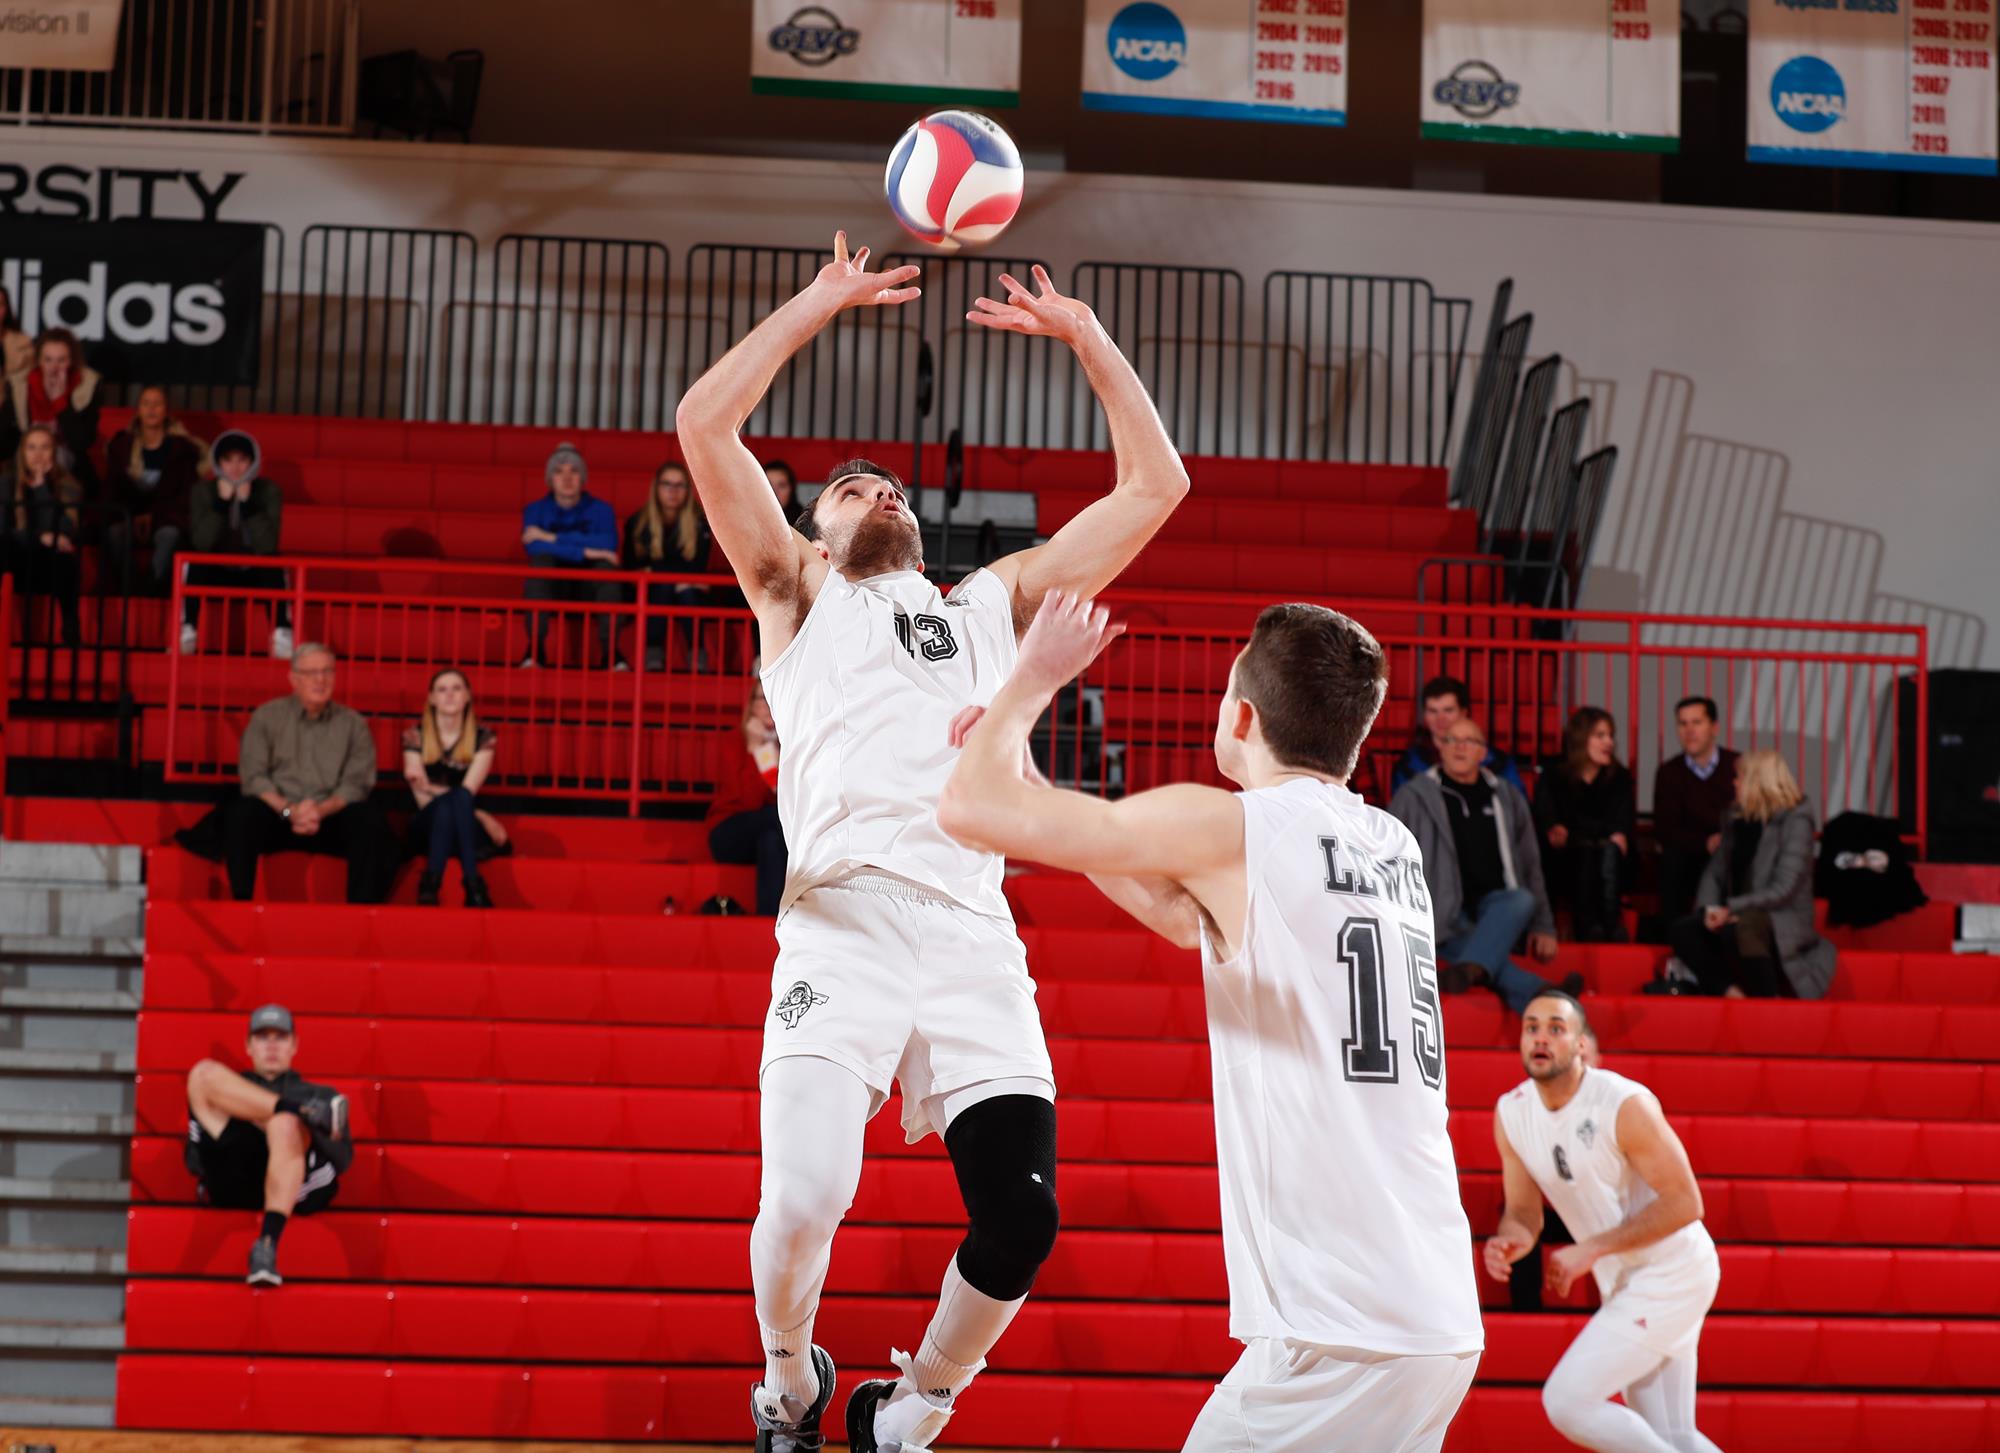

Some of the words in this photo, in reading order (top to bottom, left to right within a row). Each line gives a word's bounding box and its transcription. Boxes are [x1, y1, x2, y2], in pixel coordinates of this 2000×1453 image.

[769, 26, 860, 55] GLVC
[1113, 37, 1187, 64] NCAA
[1433, 78, 1521, 109] GLVC
[1776, 91, 1847, 117] NCAA
[894, 612, 959, 662] 13
[1317, 835, 1429, 914] LEWIS
[1336, 916, 1445, 1091] 15
